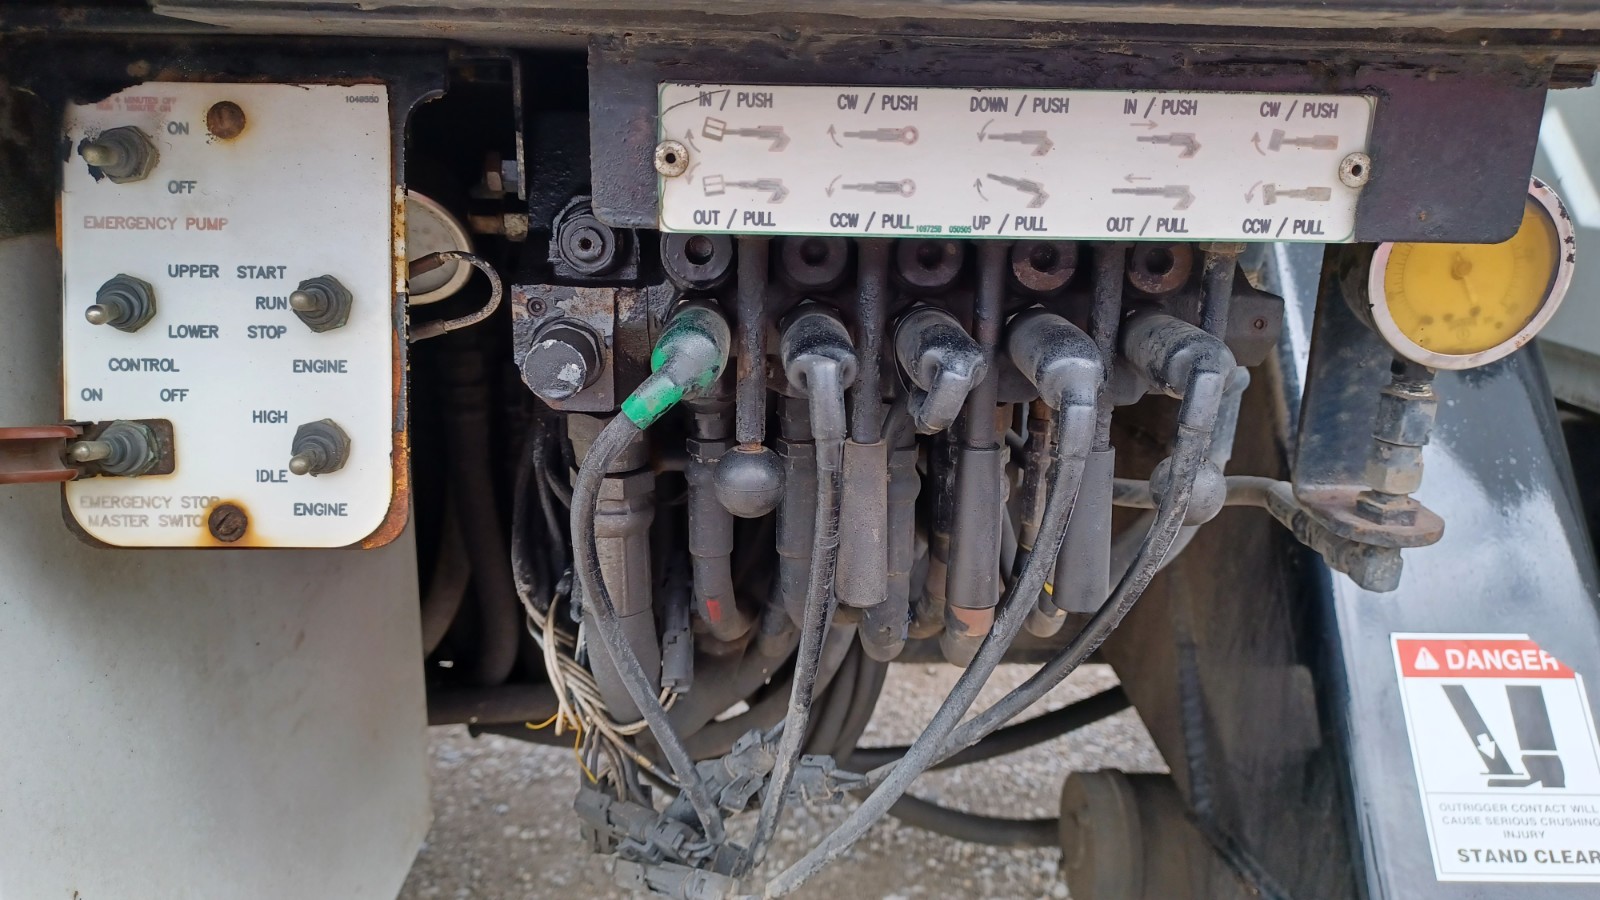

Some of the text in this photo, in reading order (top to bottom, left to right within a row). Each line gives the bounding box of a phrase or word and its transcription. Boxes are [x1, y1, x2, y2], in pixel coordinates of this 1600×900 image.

[699, 89, 773, 111] IN / PUSH
[837, 92, 918, 114] CW / PUSH
[970, 95, 1069, 117] DOWN / PUSH
[1123, 97, 1198, 119] IN / PUSH
[1260, 100, 1339, 121] CW / PUSH
[168, 121, 189, 135] ON
[168, 181, 197, 194] OFF
[84, 216, 229, 231] EMERGENCY PUMP
[693, 208, 776, 229] OUT / PULL
[830, 211, 914, 232] CCW / PULL
[972, 213, 1047, 234] UP / PULL
[1106, 215, 1188, 236] OUT / PULL
[1242, 217, 1324, 238] CCW / PULL
[168, 264, 219, 278] UPPER
[237, 265, 287, 279] START
[255, 297, 288, 310] RUN
[168, 325, 219, 339] LOWER
[247, 325, 287, 339] STOP
[108, 358, 180, 373] CONTROL
[292, 360, 348, 374] ENGINE
[81, 388, 103, 402] ON
[160, 388, 189, 402] OFF
[252, 410, 288, 424] HIGH
[256, 469, 288, 483] IDLE
[80, 496, 172, 509] EMERGENCY
[293, 503, 348, 516] ENGINE
[88, 515, 207, 528] MASTER SWITC
[1439, 803, 1599, 814] OUTRIGGER CONTACT WILL
[1442, 816, 1482, 826] CAUSE
[1485, 816, 1537, 826] SERIOUS
[1503, 830, 1545, 839] INJURY
[1457, 848, 1600, 864] STAND CLEAR
